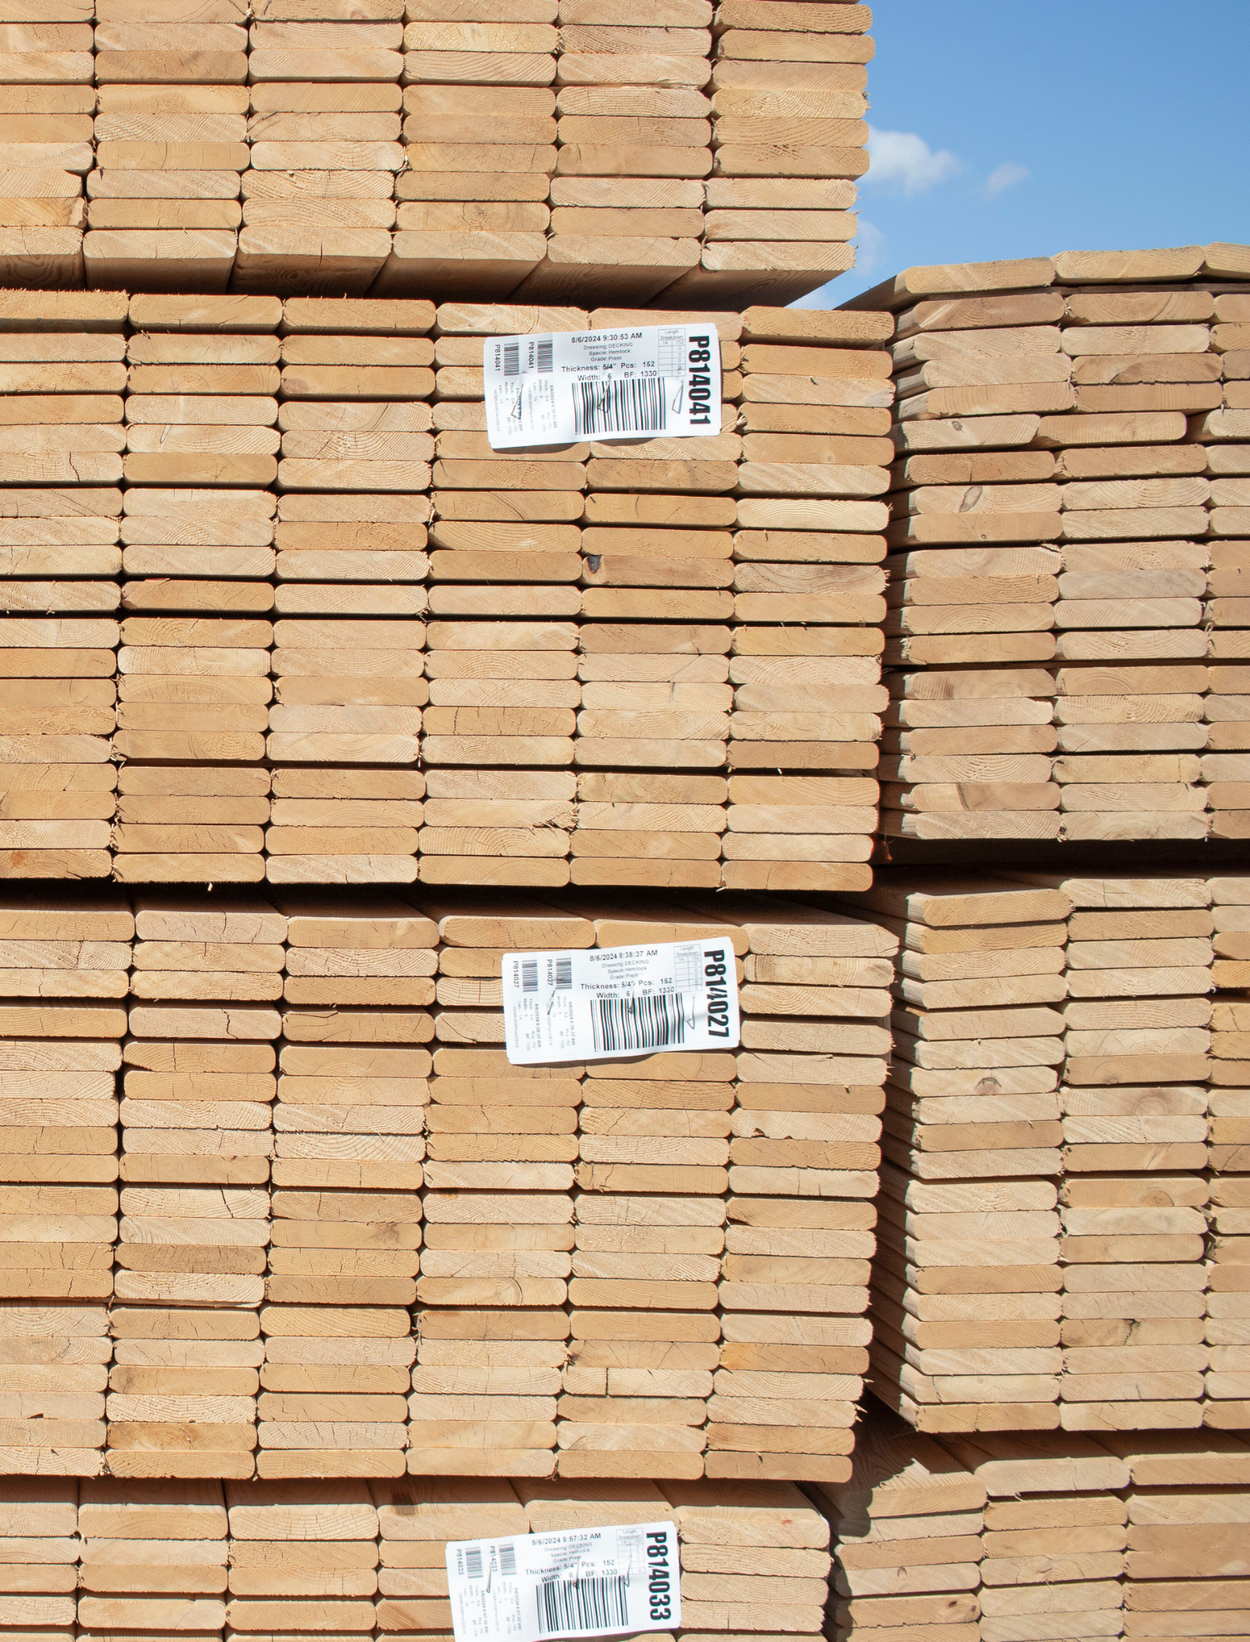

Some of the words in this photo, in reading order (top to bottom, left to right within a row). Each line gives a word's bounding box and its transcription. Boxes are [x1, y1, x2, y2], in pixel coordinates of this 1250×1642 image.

[494, 344, 502, 371] P814041
[527, 342, 535, 369] P814041
[561, 364, 600, 373] Thickness:
[689, 336, 710, 424] P814041
[589, 953, 617, 961] 8/6/2024
[512, 961, 520, 988] P814027
[546, 959, 554, 986] P814027
[581, 981, 619, 991] Thickness:
[705, 950, 729, 1037] P814027
[532, 1537, 560, 1545] 8/6/2024
[456, 1549, 464, 1575] P814033
[525, 1565, 562, 1575] Thickness:
[541, 1574, 562, 1582] Width:
[647, 1532, 671, 1620] P814033
